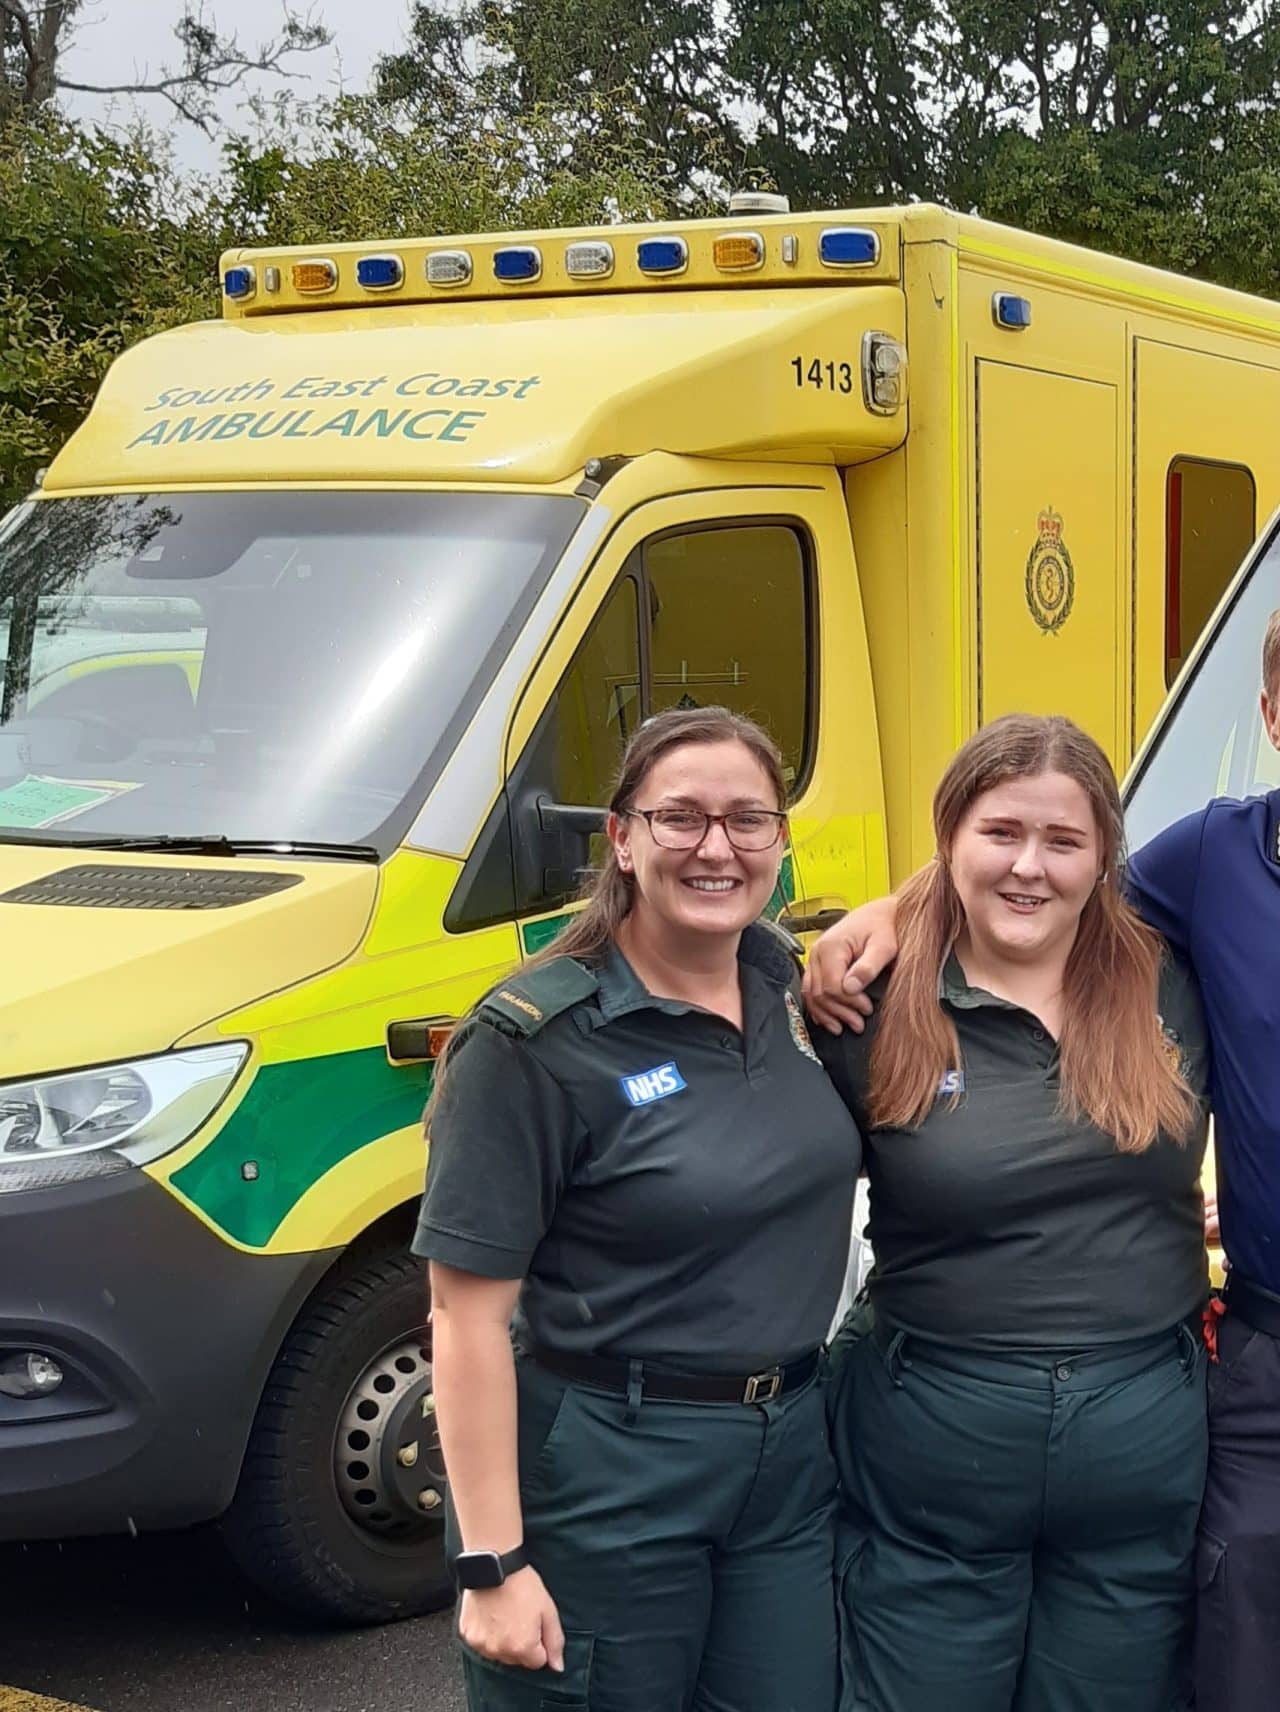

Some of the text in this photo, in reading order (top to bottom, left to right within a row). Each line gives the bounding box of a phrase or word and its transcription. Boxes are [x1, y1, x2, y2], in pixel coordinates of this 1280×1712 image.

[144, 373, 541, 411] South East Coast
[791, 356, 852, 394] 1413
[126, 408, 487, 450] AMBULANCE
[627, 1066, 678, 1102] NHS
